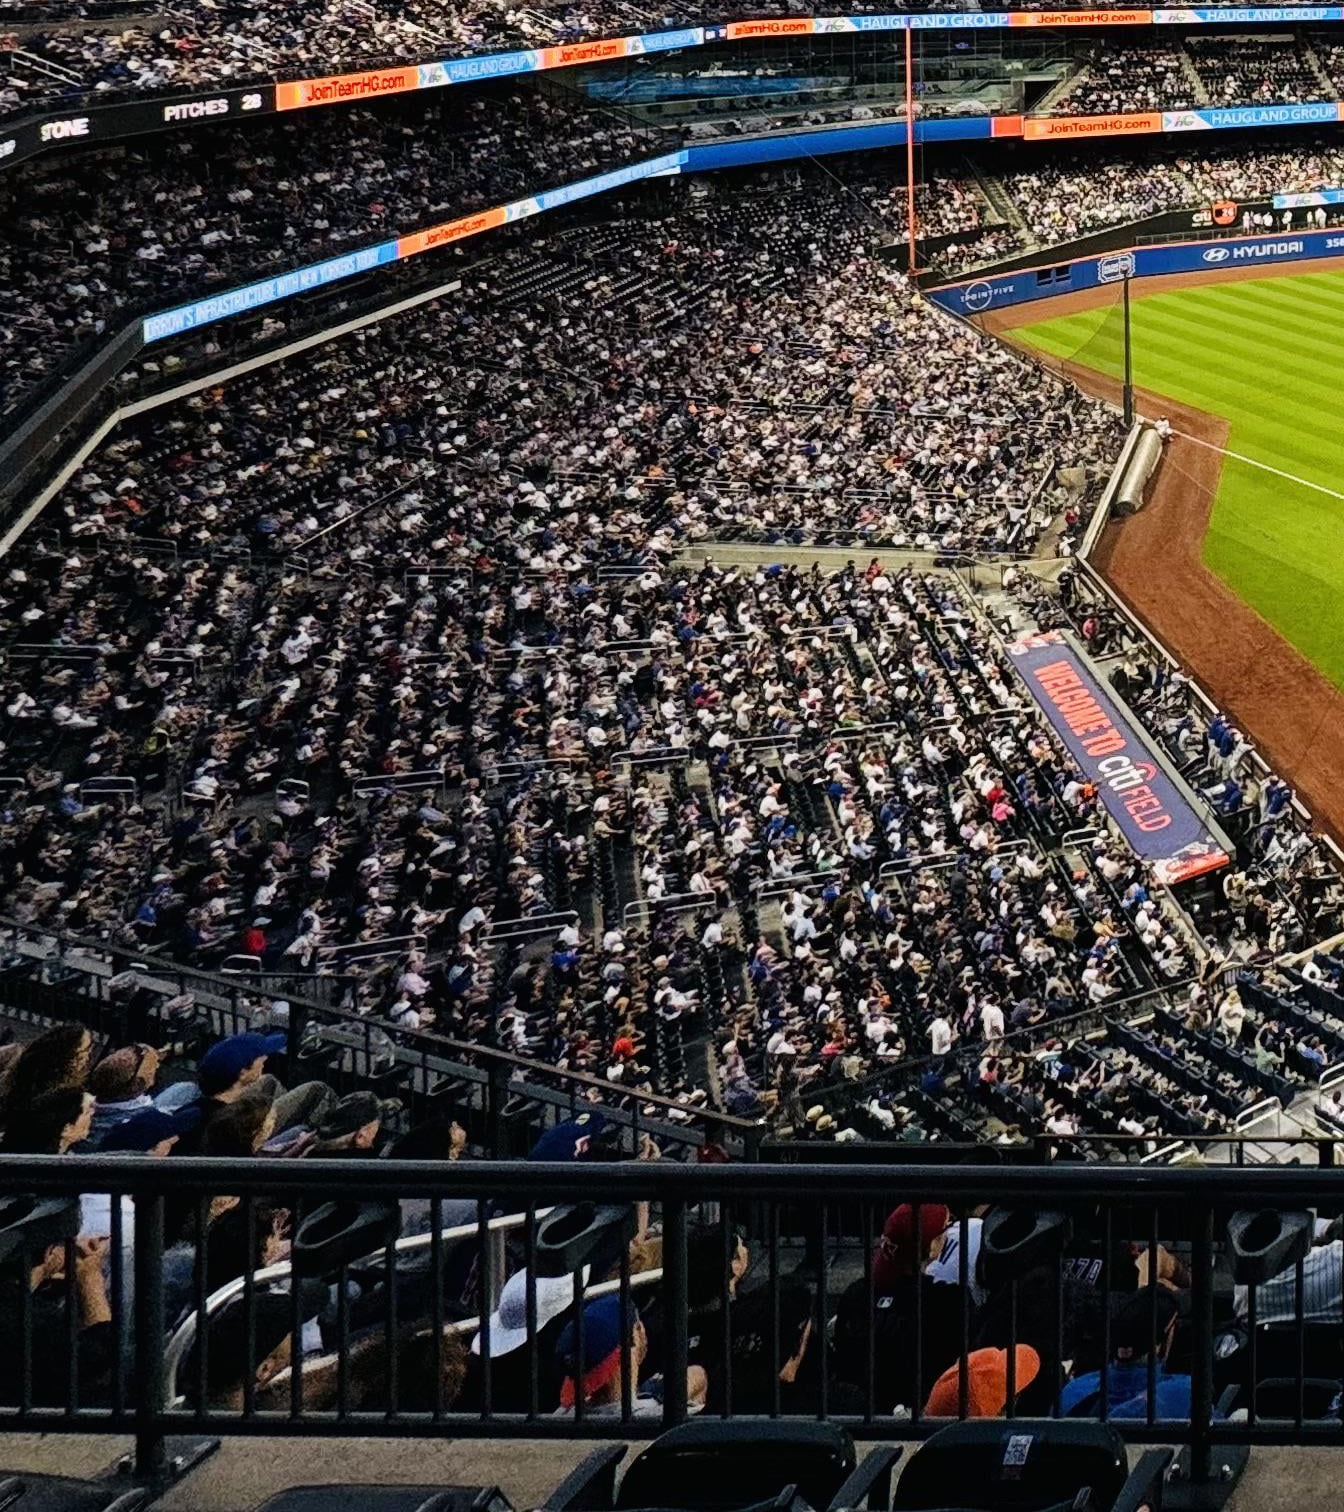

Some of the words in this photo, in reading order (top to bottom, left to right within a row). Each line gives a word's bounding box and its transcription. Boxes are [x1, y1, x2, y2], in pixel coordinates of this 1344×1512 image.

[862, 14, 949, 29] HAUGLAND
[950, 13, 1007, 27] GROUP
[1037, 12, 1136, 24] JoinTeamHG.com
[1207, 10, 1282, 21] HAUGLAND
[1284, 9, 1327, 19] GROUP
[307, 75, 405, 102] JoinTeamHG.com
[164, 99, 229, 121] PITCHES
[1212, 110, 1289, 125] HAUGLAND
[1290, 106, 1336, 119] GROUP
[40, 118, 90, 141] STONE
[1048, 119, 1150, 135] JoinTeamHG.com
[1192, 209, 1212, 223] citi
[1233, 241, 1303, 259] HYUNDAI
[1033, 660, 1112, 737] WELCOME
[1080, 725, 1127, 757] TO
[1098, 755, 1144, 792] citi
[1119, 785, 1172, 832] FIELD
